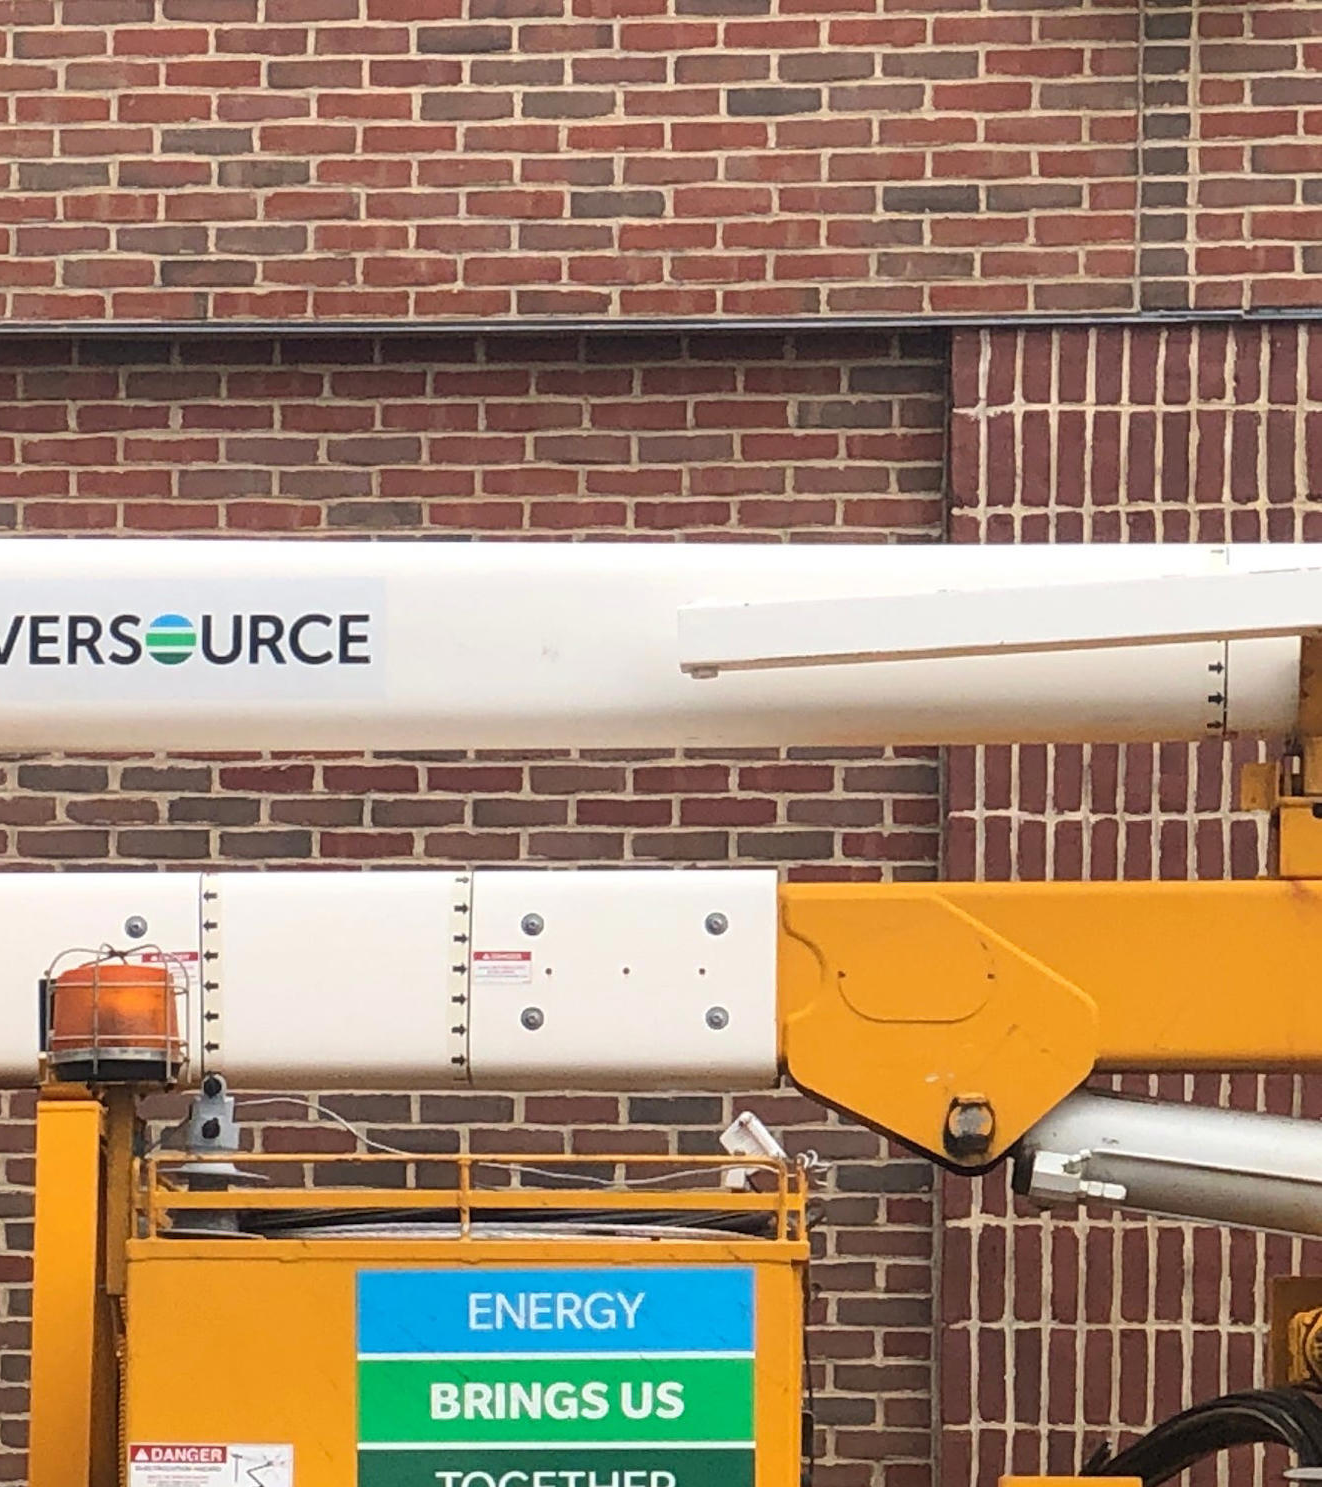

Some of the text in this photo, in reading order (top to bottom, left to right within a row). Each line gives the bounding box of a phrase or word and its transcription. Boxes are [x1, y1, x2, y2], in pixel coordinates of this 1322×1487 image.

[468, 1291, 646, 1331] ENERGY
[429, 1381, 685, 1420] BRINGS US
[150, 1447, 223, 1462] DANGER
